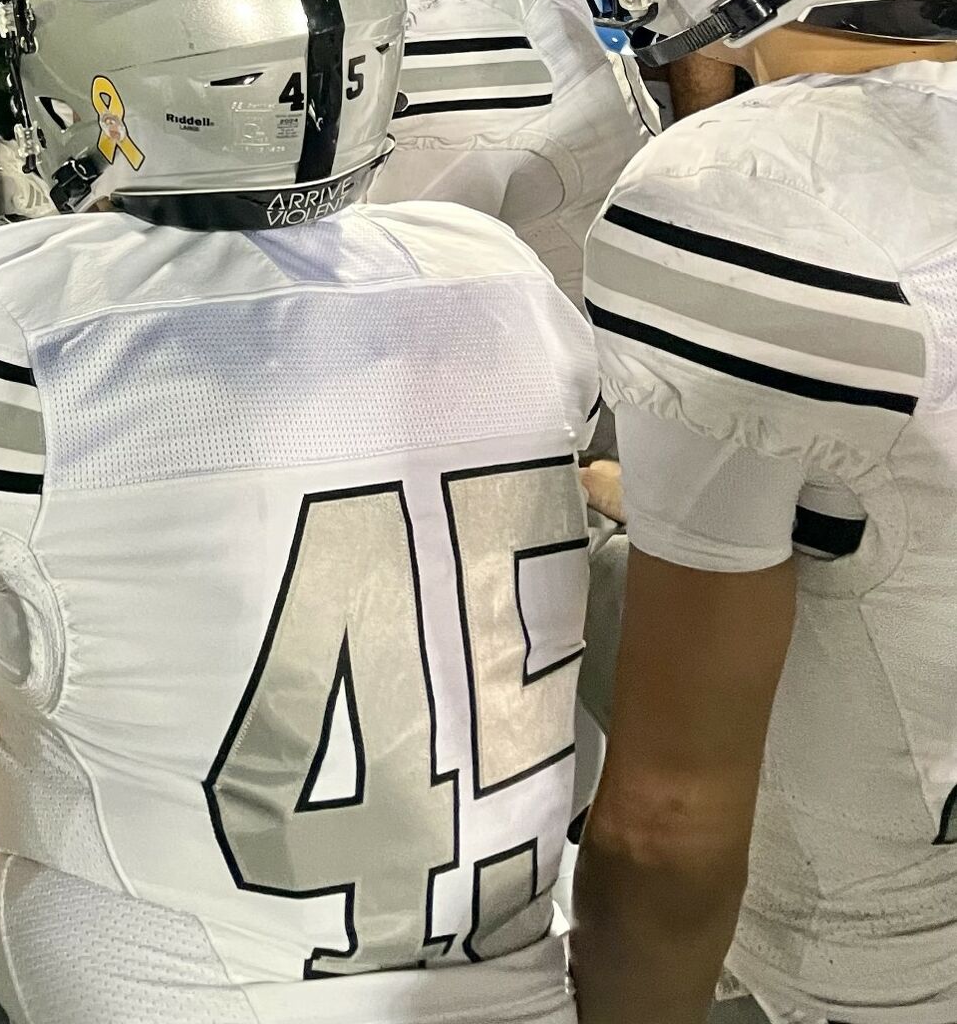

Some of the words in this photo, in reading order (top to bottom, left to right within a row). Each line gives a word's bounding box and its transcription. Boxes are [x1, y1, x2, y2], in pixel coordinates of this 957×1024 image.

[279, 72, 304, 111] 4
[346, 54, 366, 100] 5
[165, 113, 211, 126] Riddell
[267, 177, 355, 210] ARRIVE
[267, 195, 346, 226] VIOLENT
[201, 454, 590, 980] 45
